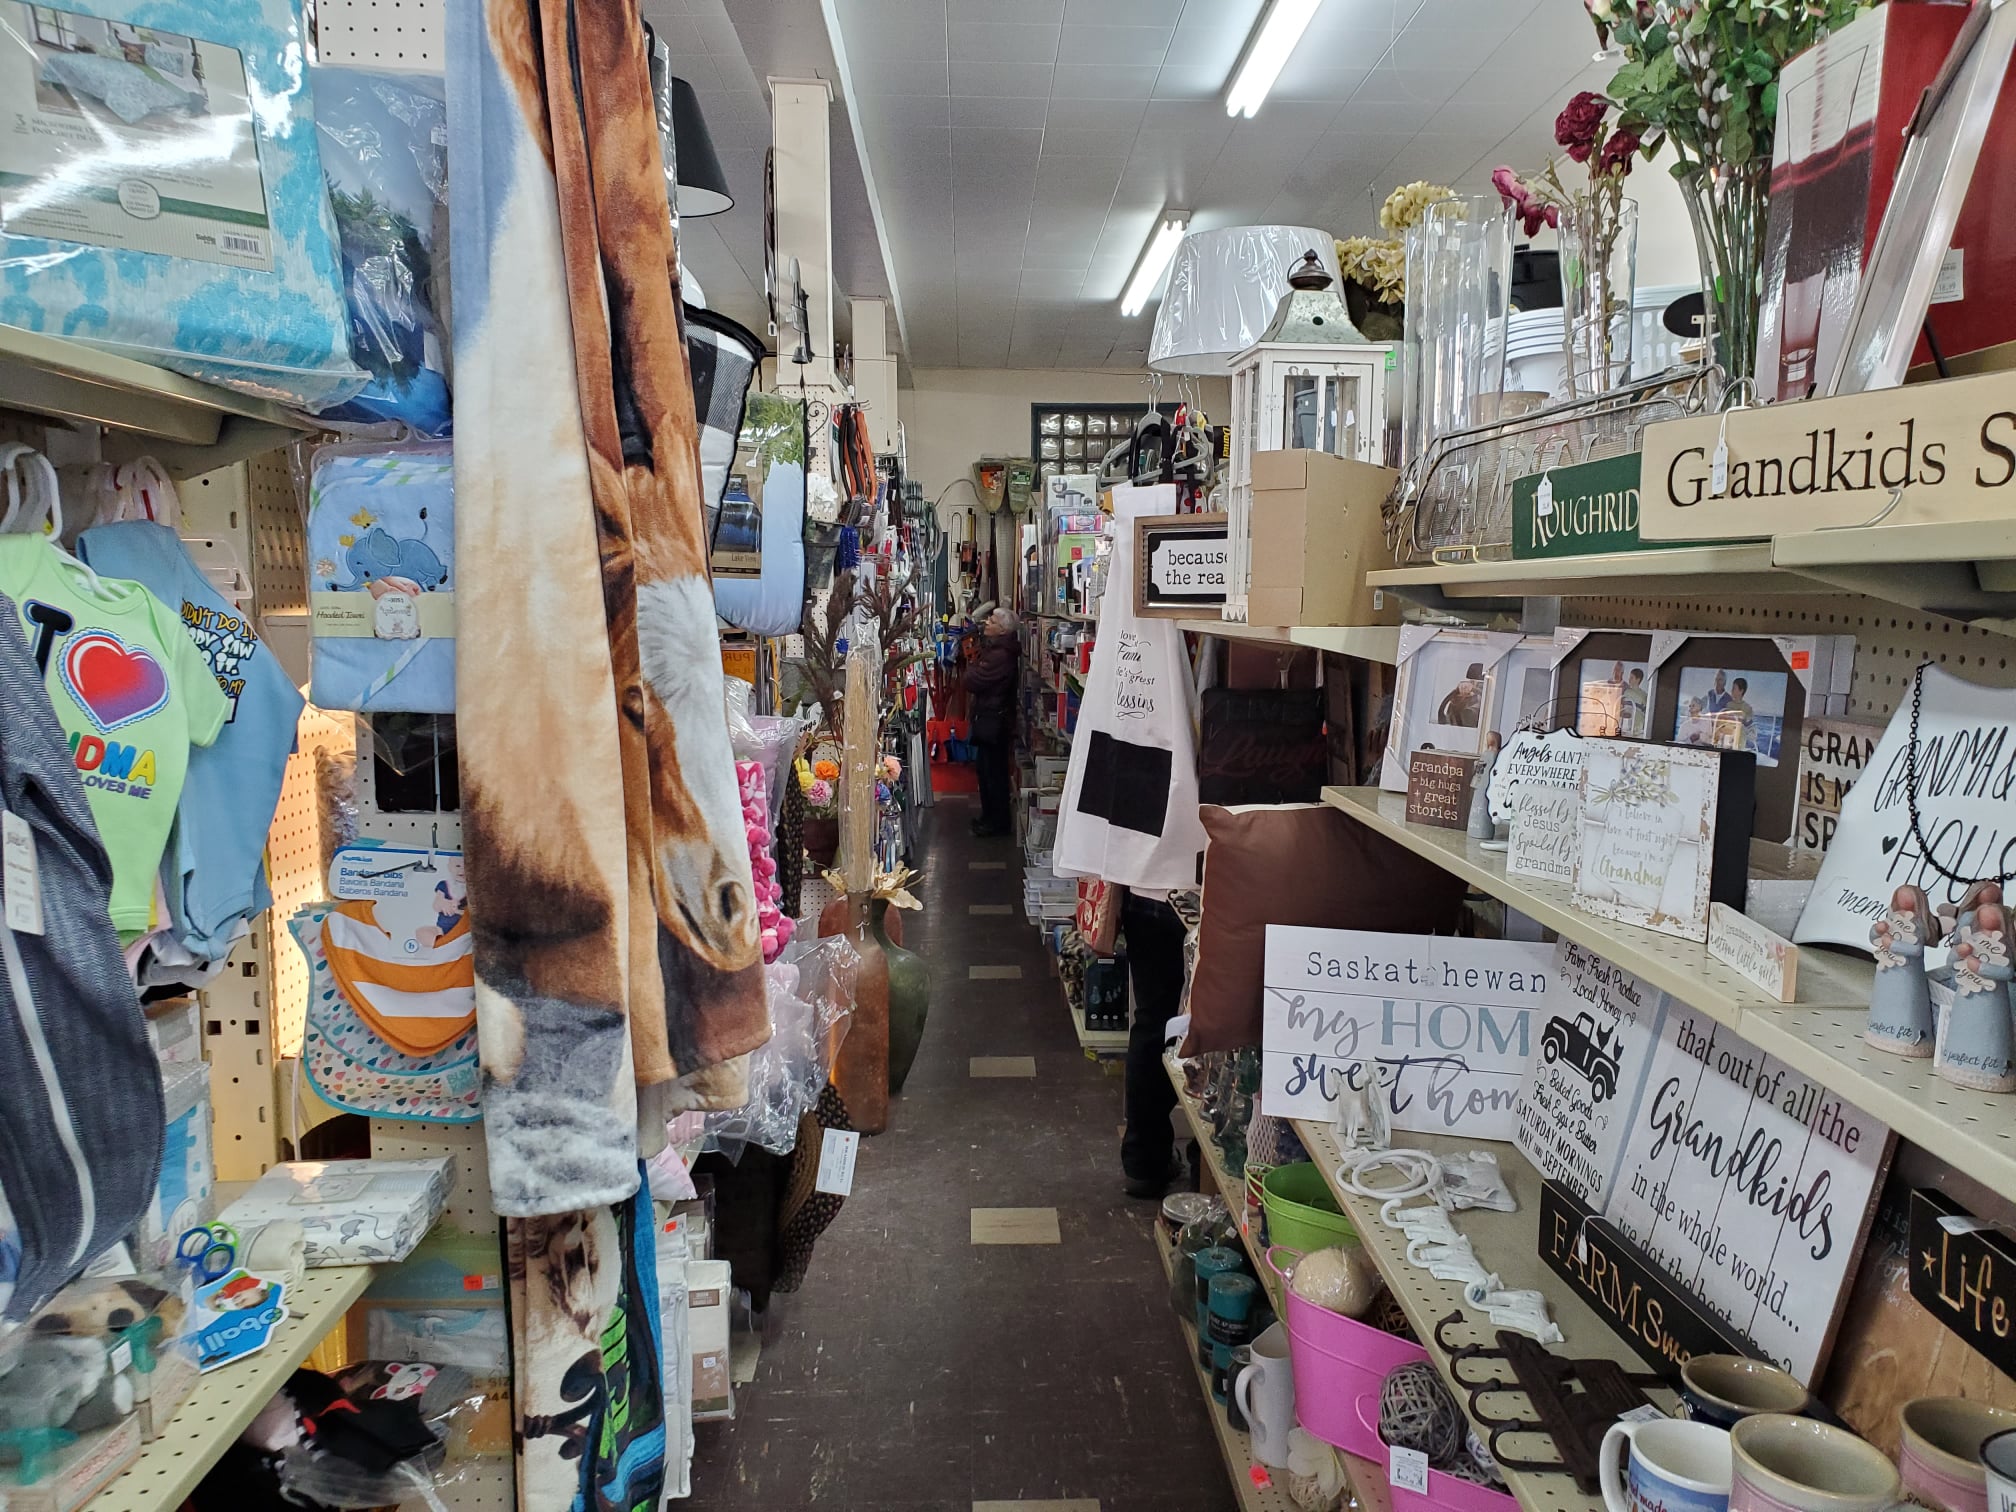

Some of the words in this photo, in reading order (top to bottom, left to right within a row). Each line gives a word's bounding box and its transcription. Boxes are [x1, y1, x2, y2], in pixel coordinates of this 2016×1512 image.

[1667, 418, 1946, 507] Gandkids
[1165, 569, 1191, 585] the
[216, 612, 239, 632] DO
[221, 632, 257, 660] SAW
[1512, 742, 1552, 764] Angels
[1411, 761, 1464, 778] grandpa
[1507, 763, 1577, 781] EVERYWHERE
[128, 783, 153, 800] ME
[1420, 776, 1436, 789] big
[1438, 779, 1461, 793] hugs
[1807, 770, 1826, 804] IS
[1423, 793, 1457, 806] great
[1409, 803, 1458, 821] stories
[1523, 814, 1561, 832] Jesus
[1515, 856, 1571, 877] grandma
[1894, 918, 1913, 935] me
[1875, 944, 1896, 963] you
[1978, 937, 2001, 955] me
[1306, 951, 1547, 993] Saskathewan
[1564, 941, 1587, 971] Farm
[1586, 953, 1612, 986] Fresh
[1611, 968, 1642, 1008] Produce
[1956, 967, 1983, 989] you
[1572, 973, 1599, 1004] Local
[1595, 987, 1623, 1028] Honey
[1267, 988, 1375, 1059] my
[1381, 999, 1531, 1058] HOM
[1895, 1024, 1913, 1040] fit
[1946, 1050, 1981, 1068] perfect
[1981, 1054, 2000, 1071] fit
[1675, 1018, 1716, 1067] that
[1717, 1050, 1754, 1090] out
[1755, 1070, 1786, 1106] of
[1782, 1083, 1818, 1128] all
[1817, 1101, 1862, 1155] the
[1568, 1088, 1594, 1121] Goods
[1516, 1098, 1558, 1147] SATURDAY
[1555, 1135, 1604, 1194] MORNINGS
[1518, 1123, 1535, 1151] MAY
[1650, 1076, 1833, 1261] Grandkids
[1630, 1164, 1649, 1201] in
[1649, 1181, 1676, 1223] the
[1677, 1207, 1729, 1267] whole
[1618, 1217, 1638, 1243] we
[1938, 1230, 2011, 1339] Life
